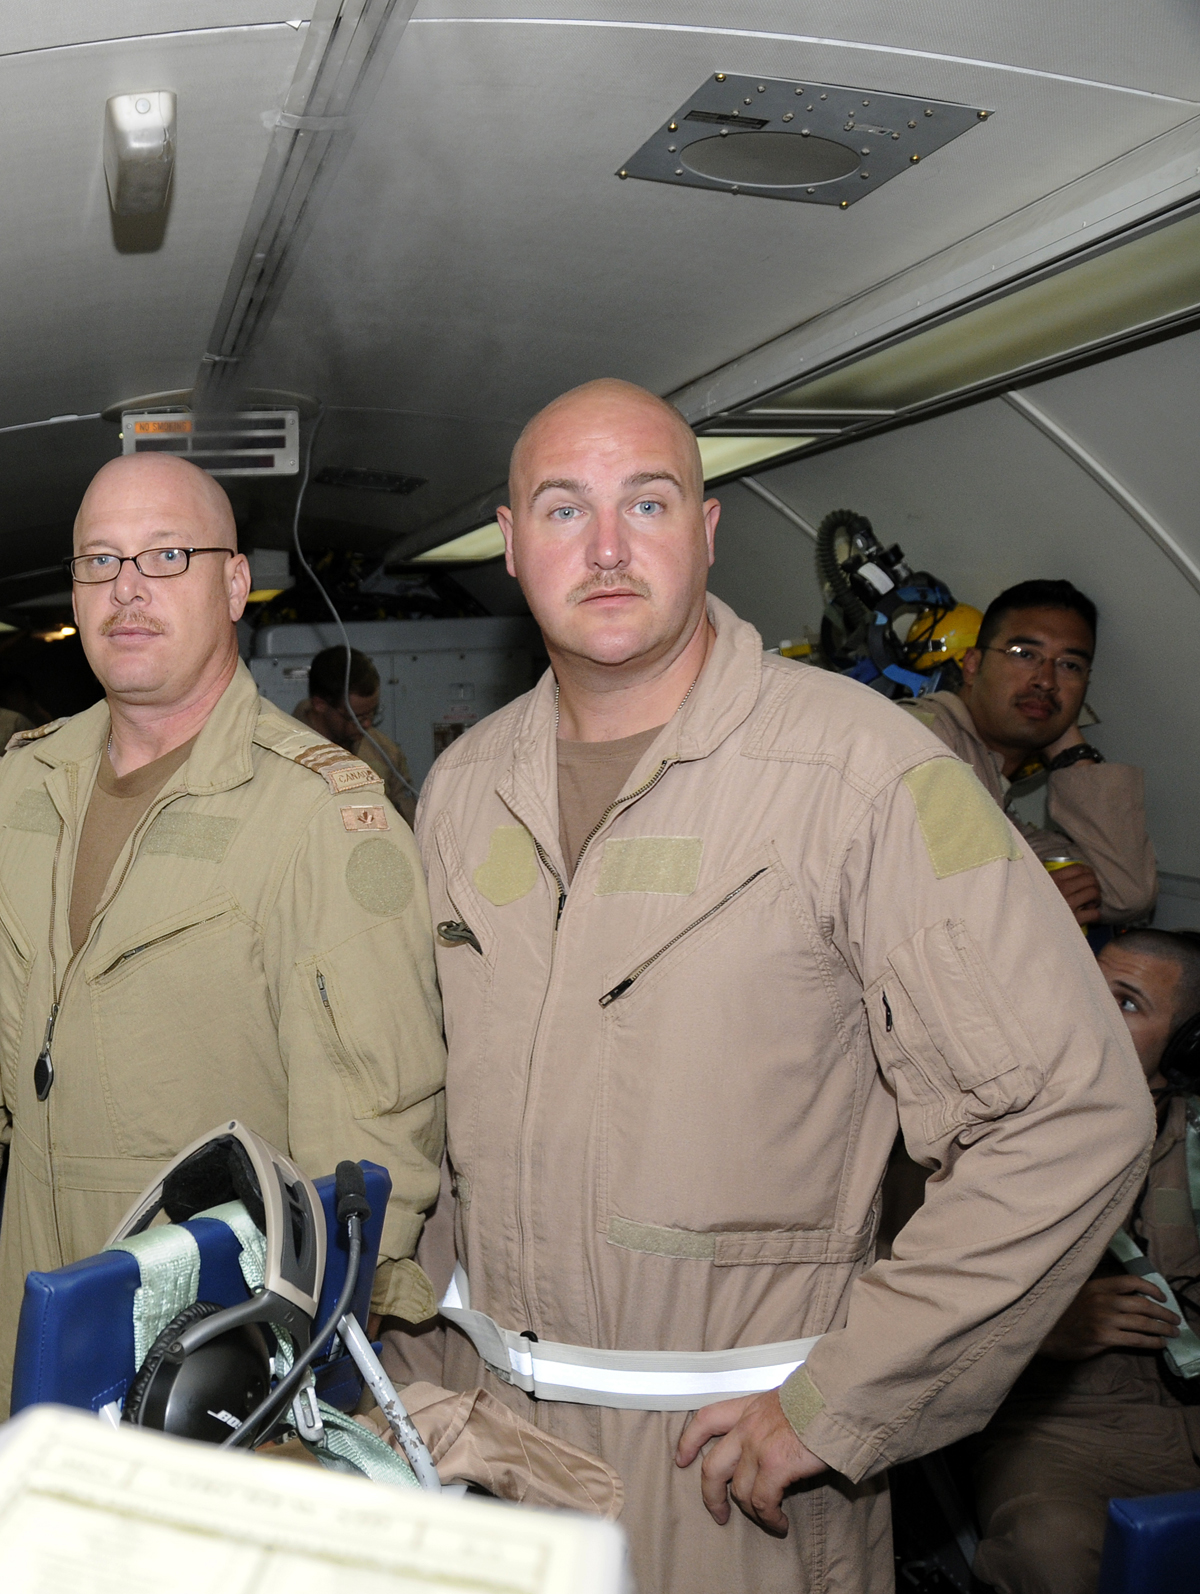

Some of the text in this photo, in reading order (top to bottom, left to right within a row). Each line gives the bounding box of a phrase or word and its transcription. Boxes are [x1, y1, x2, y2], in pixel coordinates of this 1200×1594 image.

[139, 421, 187, 432] NO SMOKING
[206, 1409, 243, 1430] BO
